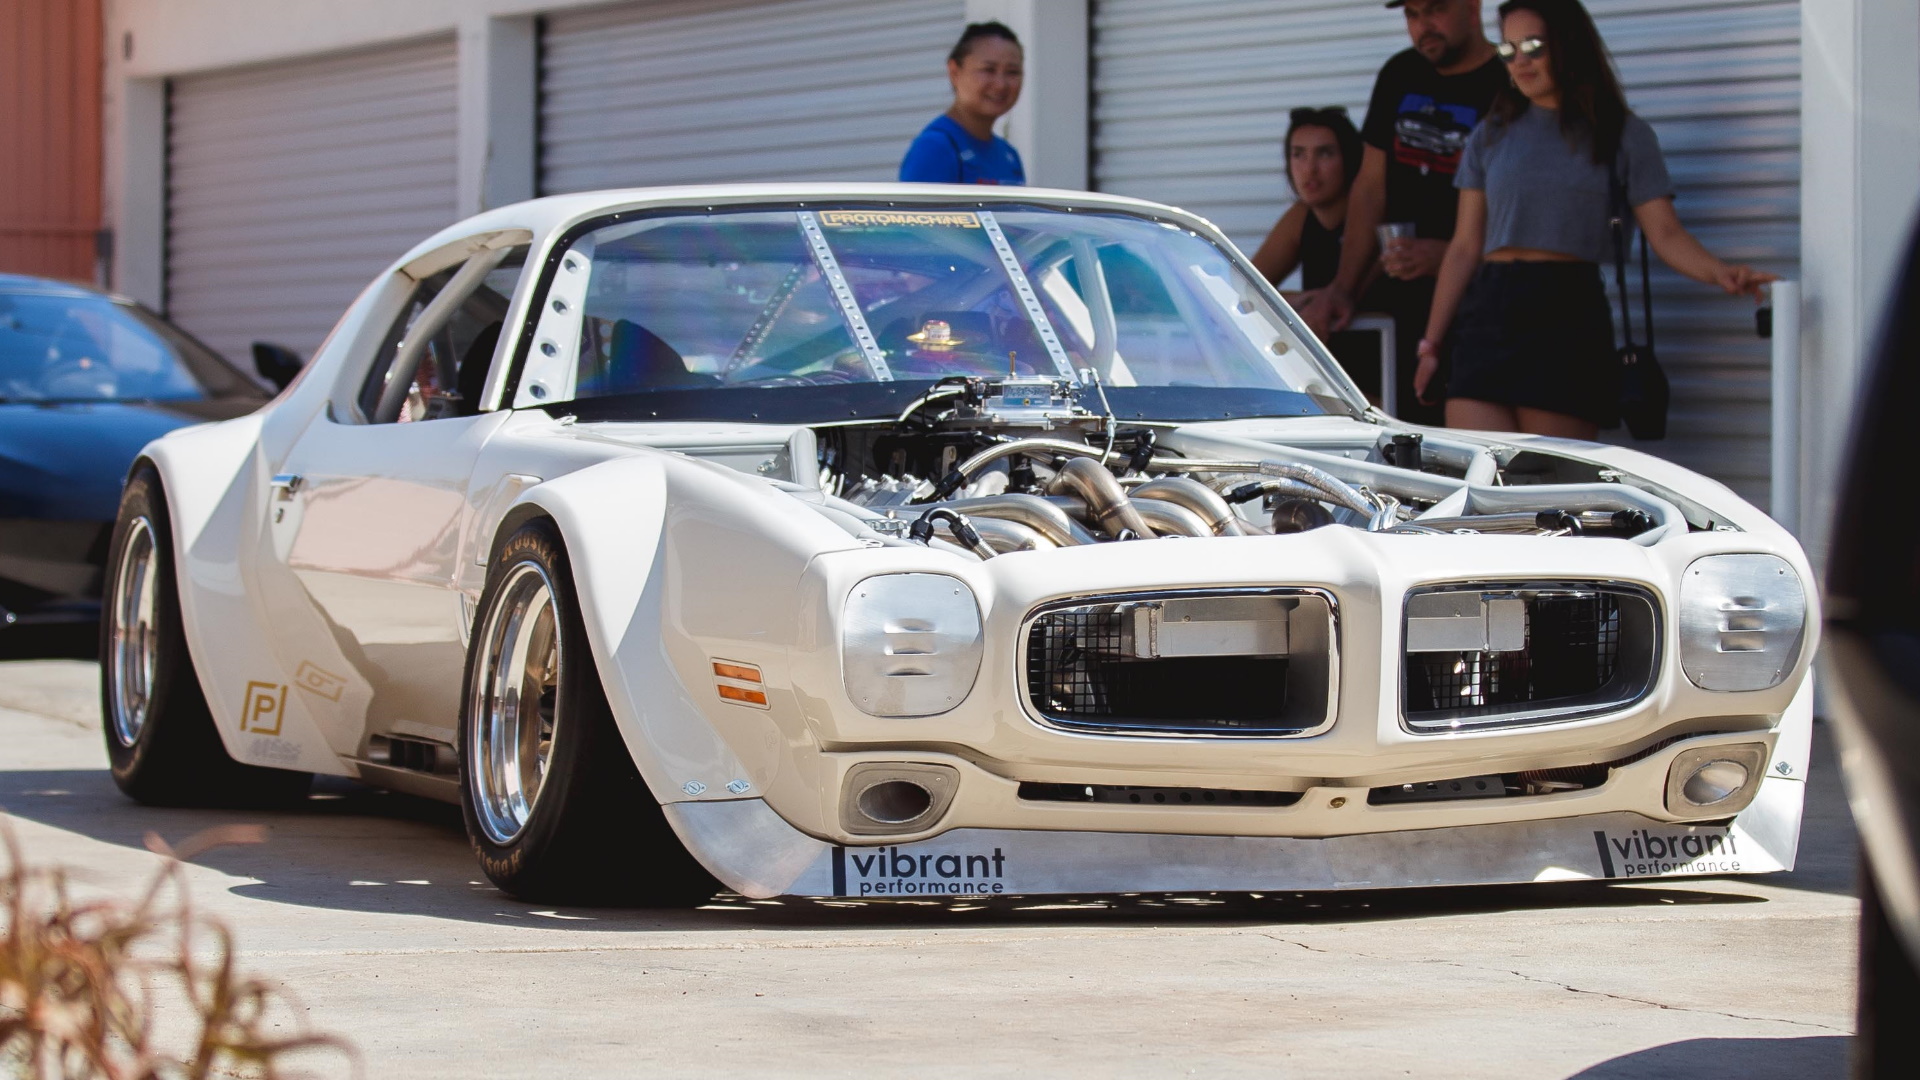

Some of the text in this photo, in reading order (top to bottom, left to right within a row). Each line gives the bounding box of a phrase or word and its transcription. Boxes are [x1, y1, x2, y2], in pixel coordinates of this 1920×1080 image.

[252, 693, 276, 721] P
[1611, 827, 1737, 859] vibrant
[851, 846, 1006, 878] vibrant
[1624, 860, 1741, 877] performance
[859, 879, 1004, 896] performance
